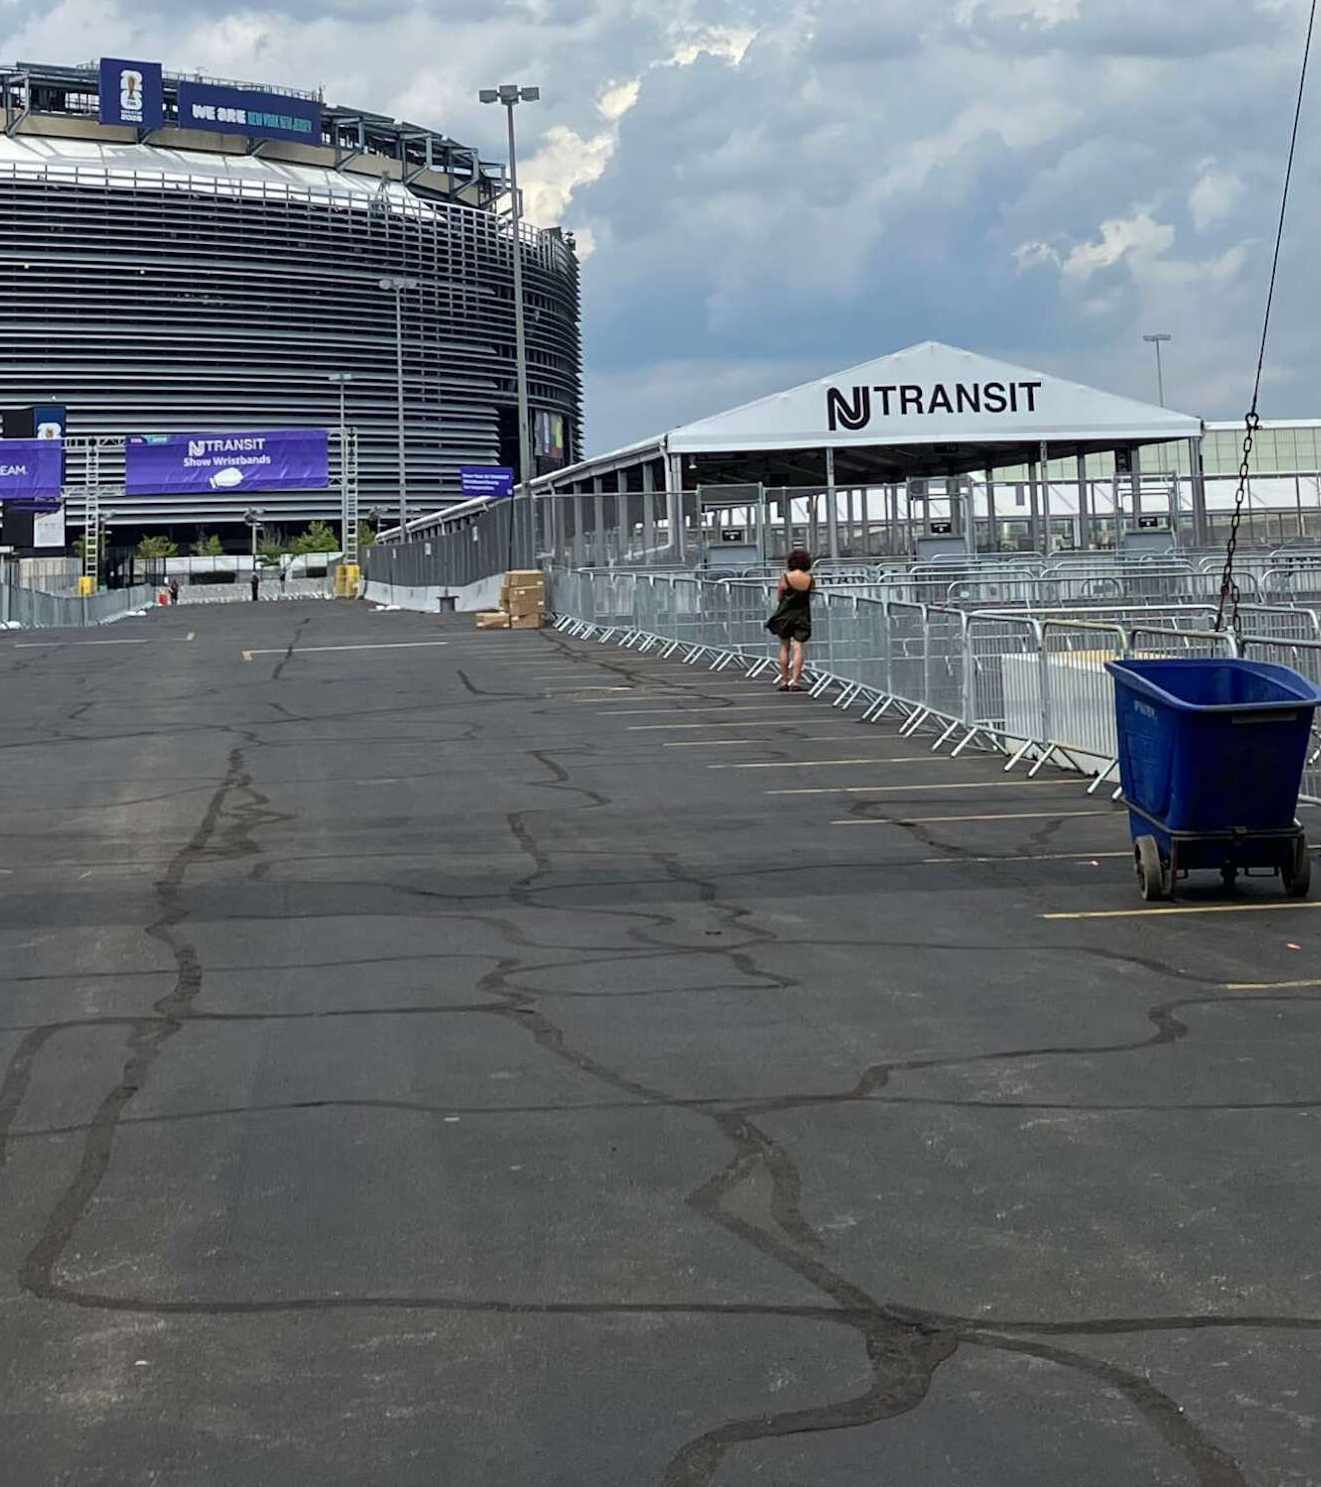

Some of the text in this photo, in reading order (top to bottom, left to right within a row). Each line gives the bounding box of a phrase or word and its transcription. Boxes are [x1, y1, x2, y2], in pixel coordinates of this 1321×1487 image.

[191, 104, 216, 120] WE
[183, 454, 272, 467] Show Wristbands
